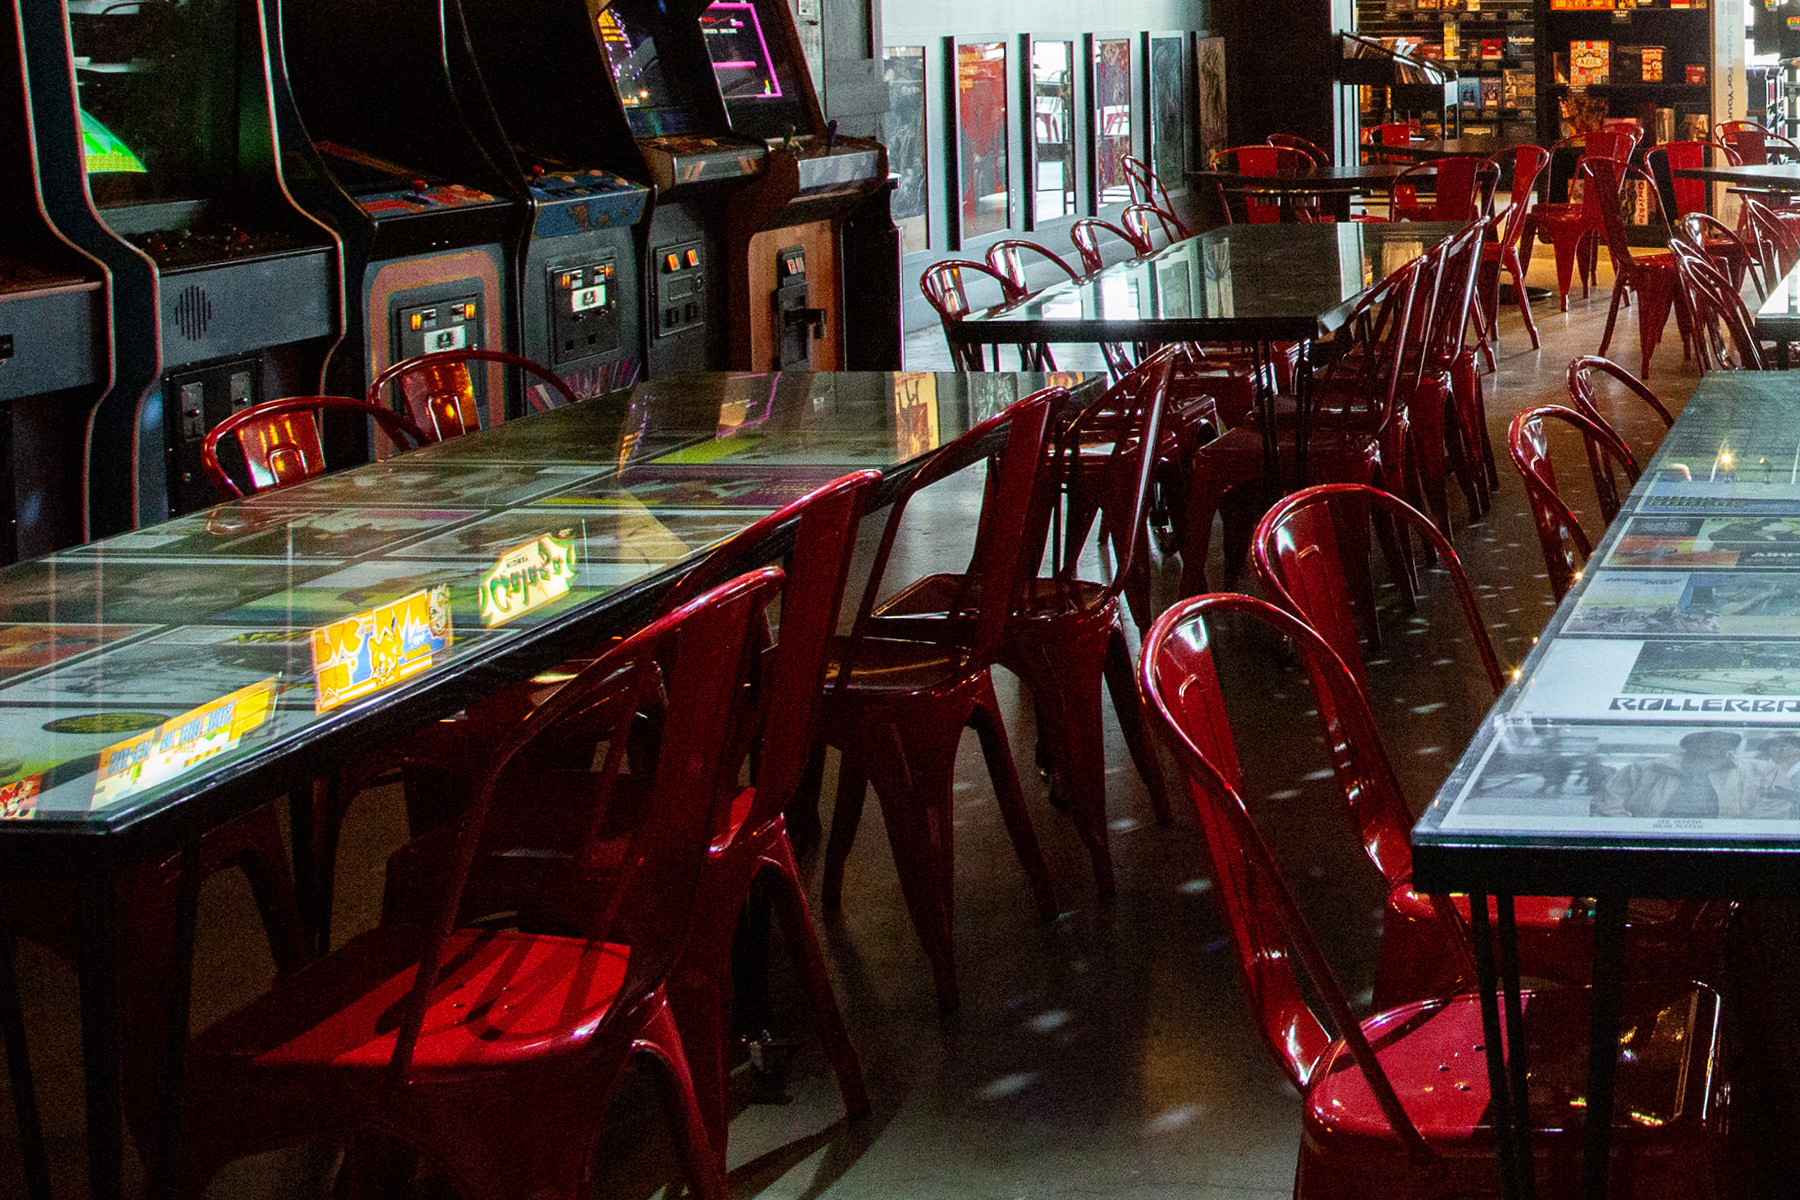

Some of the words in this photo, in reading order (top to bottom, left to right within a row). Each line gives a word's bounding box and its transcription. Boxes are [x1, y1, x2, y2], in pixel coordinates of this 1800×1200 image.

[1726, 24, 1734, 65] Video
[1579, 57, 1602, 67] AZUL
[1726, 66, 1734, 89] For
[1726, 91, 1734, 120] Your
